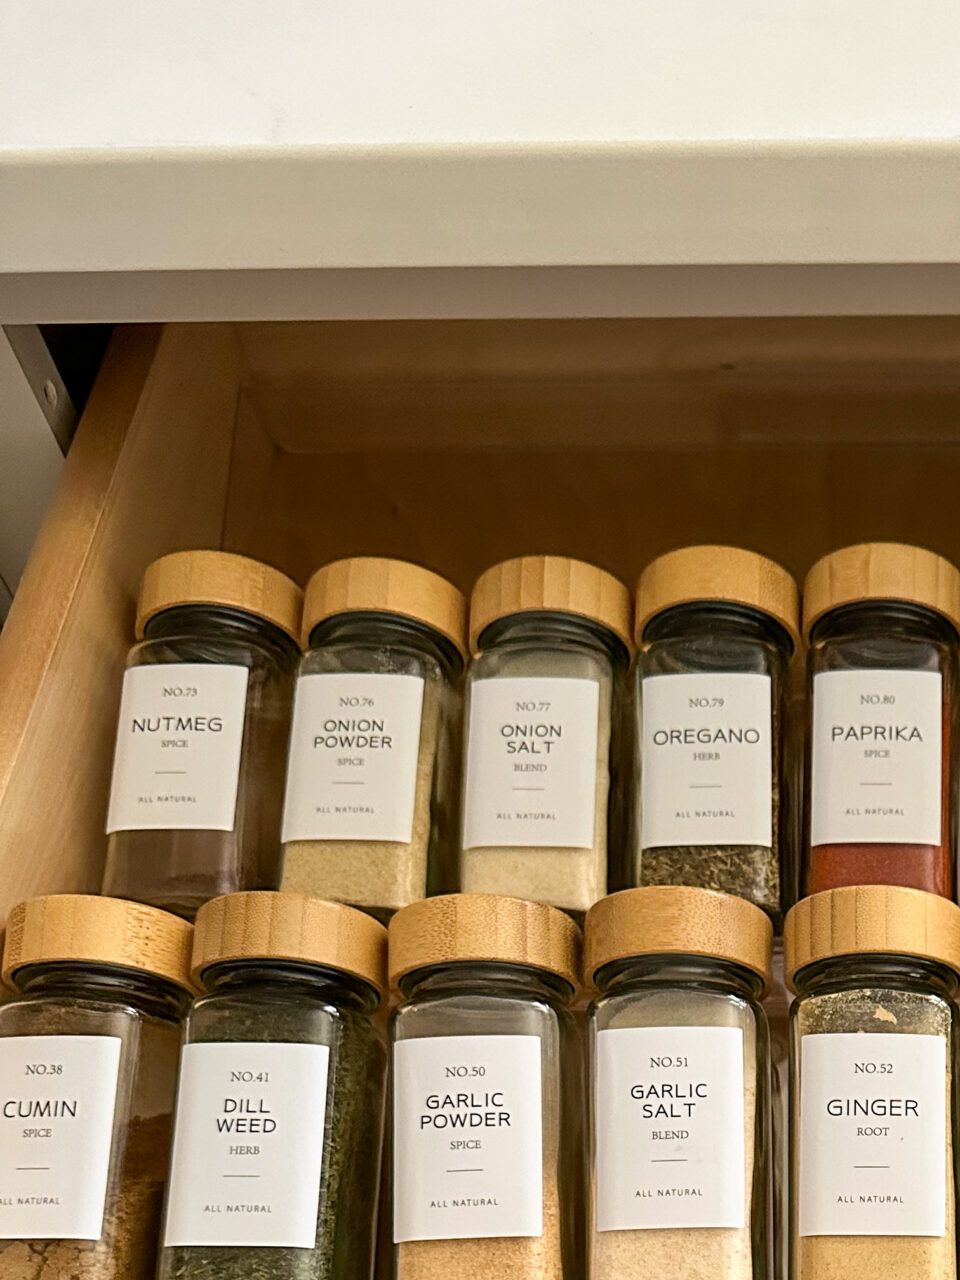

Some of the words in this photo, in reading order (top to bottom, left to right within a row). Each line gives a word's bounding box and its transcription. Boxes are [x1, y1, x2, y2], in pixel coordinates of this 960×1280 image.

[162, 686, 198, 698] NO.73
[338, 696, 375, 708] NO.76
[515, 701, 552, 712] NO.77
[688, 697, 725, 709] NO.79
[133, 715, 223, 733] NUTMEG
[322, 718, 385, 733] ONION
[499, 723, 563, 738] ONION
[652, 727, 761, 746] OREGANO
[830, 724, 924, 743] PAPRIKA
[160, 739, 189, 749] SPICE
[313, 734, 393, 750] POWDER
[506, 740, 556, 755] SALT
[692, 751, 721, 762] HERB
[863, 749, 891, 759] SPICE
[337, 757, 365, 767] SPICE
[513, 762, 548, 773] BLEND
[137, 796, 153, 804] ALL
[156, 795, 197, 804] NATURAL
[315, 806, 331, 814] ALL
[334, 805, 374, 815] NATURAL
[675, 811, 691, 819] ALL
[694, 809, 735, 818] NATURAL
[845, 808, 861, 816] ALL
[864, 807, 905, 817] NATURAL
[496, 812, 512, 820] ALL
[515, 812, 556, 821] NATURAL
[649, 1056, 689, 1069] NO.51
[853, 1062, 894, 1075] NO.52
[24, 1063, 64, 1076] NO.38
[444, 1065, 486, 1079] NO.50
[229, 1070, 269, 1083] NO.41
[630, 1082, 708, 1100] GARLIC
[222, 1098, 272, 1114] DILL
[425, 1091, 504, 1110] GARLIC
[1, 1099, 78, 1119] CUMIN
[642, 1102, 697, 1119] SALT
[826, 1098, 920, 1118] GINGER
[215, 1117, 277, 1134] WEED
[419, 1111, 512, 1131] POWDER
[21, 1128, 53, 1139] SPICE
[651, 1129, 690, 1141] BLEND
[856, 1126, 891, 1137] ROOT
[228, 1145, 261, 1156] HERB
[449, 1139, 483, 1151] SPICE
[634, 1189, 653, 1198] ALL
[656, 1188, 703, 1197] NATURAL
[17, 1196, 61, 1206] NATURAL
[429, 1199, 449, 1209] ALL
[451, 1197, 500, 1208] NATURAL
[836, 1195, 855, 1204] ALL
[858, 1195, 905, 1204] NATURAL
[203, 1204, 222, 1213] ALL
[226, 1204, 272, 1214] NATURAL
